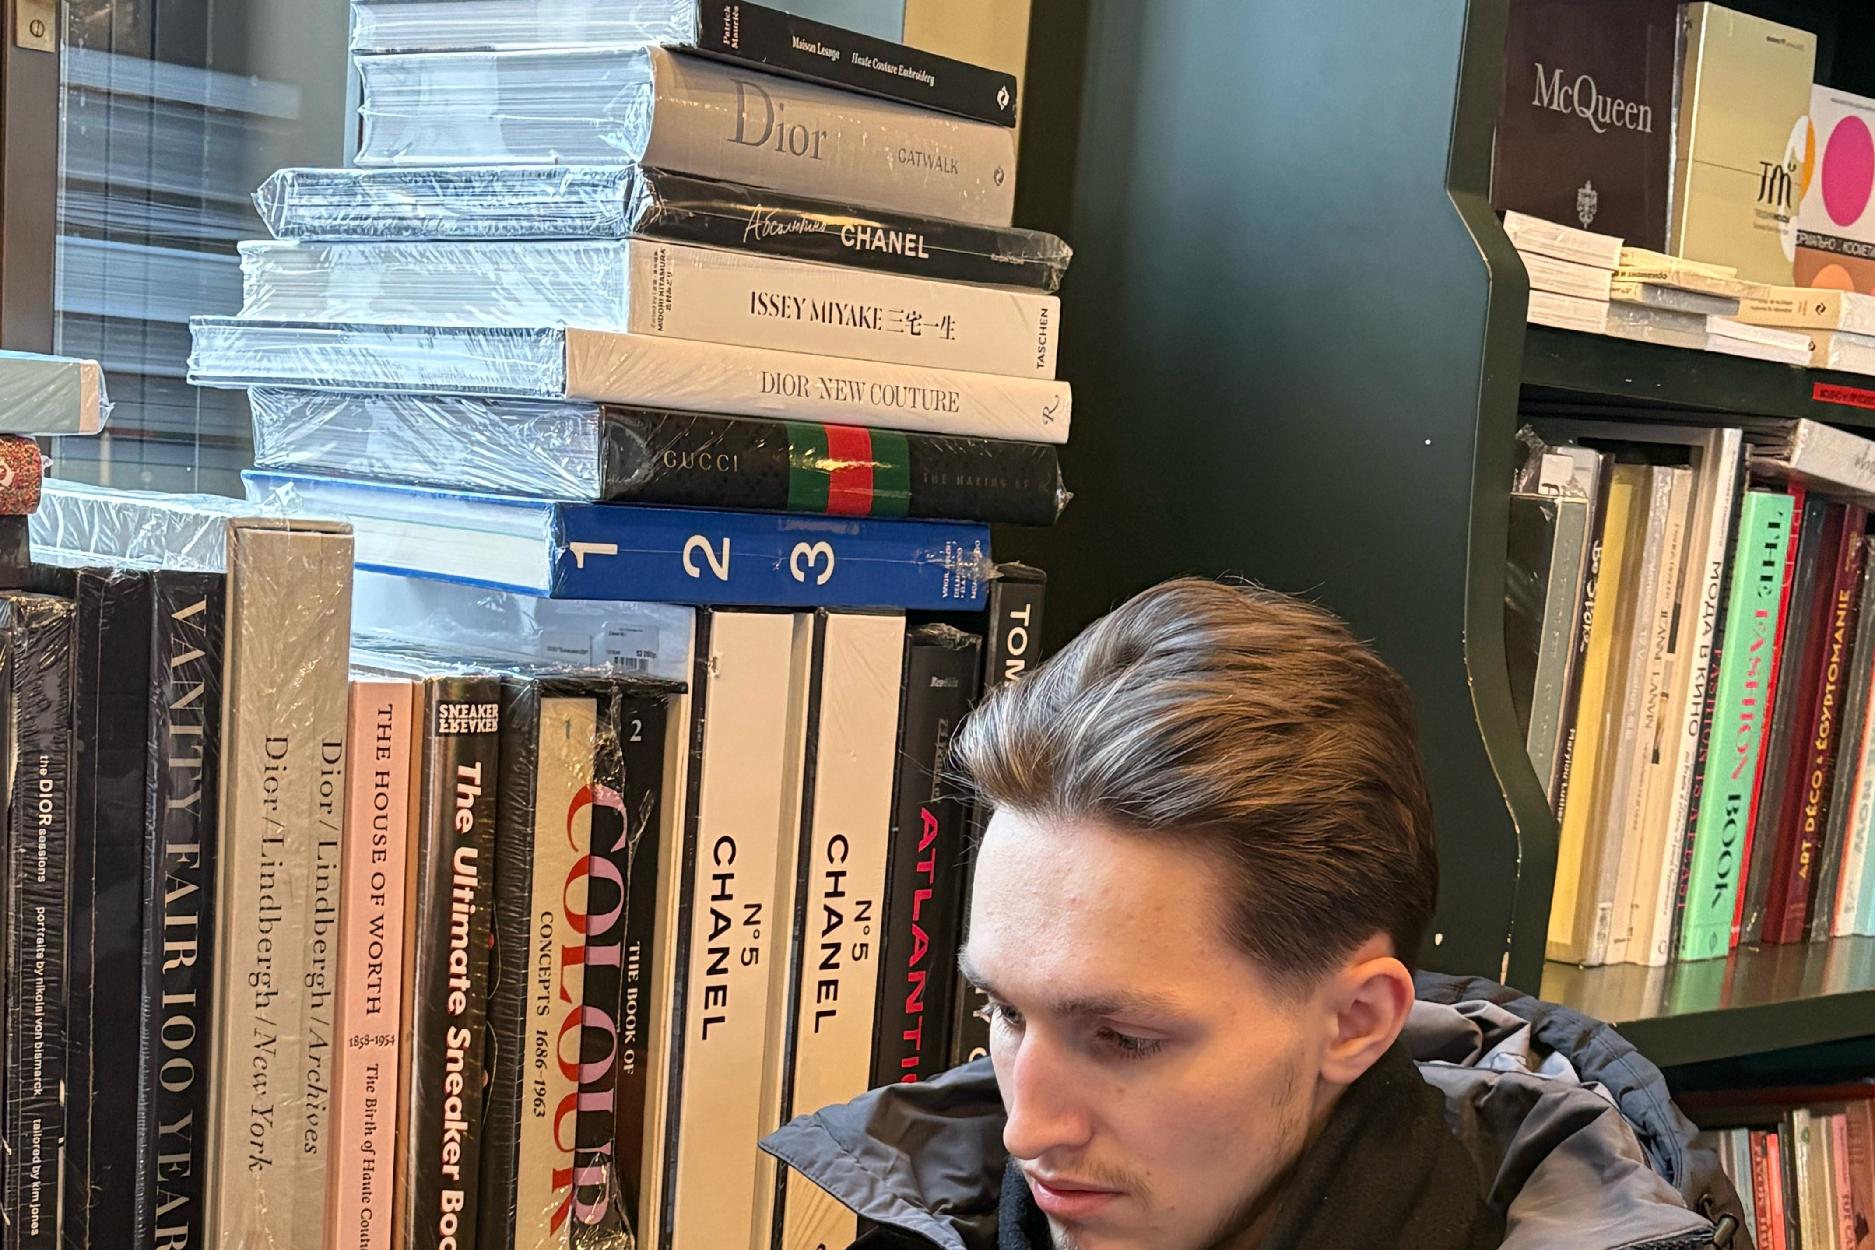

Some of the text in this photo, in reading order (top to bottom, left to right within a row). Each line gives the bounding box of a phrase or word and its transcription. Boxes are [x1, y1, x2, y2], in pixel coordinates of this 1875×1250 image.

[723, 6, 731, 45] Patrick
[792, 36, 840, 61] Maison Lesage
[851, 52, 935, 87] Haute Couture Embroidery
[727, 79, 828, 161] Dior
[1532, 63, 1653, 134] McQueen
[898, 147, 959, 175] CATWALK
[840, 224, 930, 259] CHANEL
[750, 290, 957, 341] ISSEY MIYAKE 三宅一生
[1036, 307, 1049, 370] TASCHEN
[761, 371, 960, 414] DIOR NEW COUTURE
[663, 449, 739, 473] GUCCI
[569, 534, 835, 585] 1 2 3
[1689, 561, 1722, 737] МОДА В КИНО
[1816, 589, 1851, 750] ÉGYPTOMANIE
[168, 594, 208, 817] VANITY
[439, 703, 498, 718] SNEAKER
[1646, 670, 1660, 730] LANVIN
[1712, 510, 1784, 909] THE FASHION BOOK
[629, 719, 642, 743] 2
[39, 779, 53, 827] DIOR
[454, 762, 482, 834] The
[1805, 769, 1824, 832] DÉCO
[37, 828, 46, 883] sessions
[365, 704, 393, 1017] THE HOUSE OF WORTH
[1799, 841, 1812, 879] ART
[34, 906, 46, 959] portraits
[161, 841, 201, 975] FAIR
[447, 847, 479, 1016] Ultimate
[814, 834, 849, 1035] CHANEL
[536, 911, 554, 1017] CONCEPTS
[701, 835, 736, 1041] CHANEL
[33, 961, 45, 976] by
[34, 1018, 43, 1040] von
[550, 783, 628, 1238] COLOUR
[623, 942, 640, 1076] THE BOOK OF
[349, 1033, 395, 1049] 1858-1954
[33, 1042, 45, 1096] bismarck
[364, 1064, 380, 1093] The
[363, 1097, 378, 1138] Birth
[442, 1026, 471, 1182] Sneaker
[248, 1104, 275, 1173] York
[360, 1139, 376, 1154] of
[29, 1119, 42, 1236] tailored by kim jones
[360, 1159, 376, 1205] Haute
